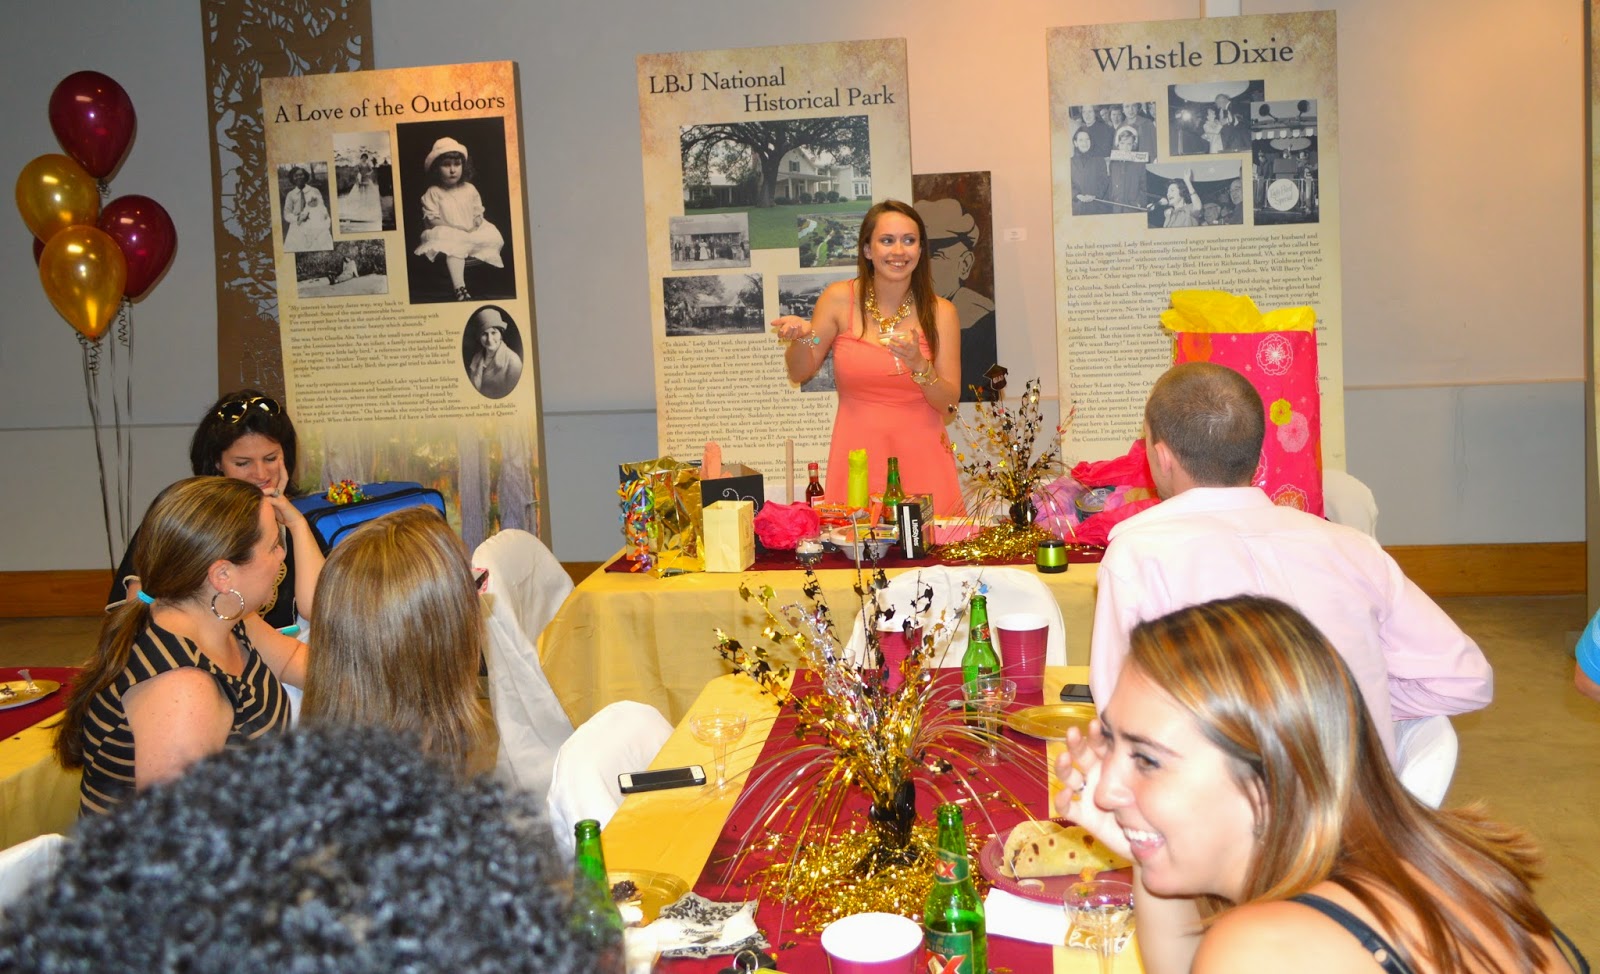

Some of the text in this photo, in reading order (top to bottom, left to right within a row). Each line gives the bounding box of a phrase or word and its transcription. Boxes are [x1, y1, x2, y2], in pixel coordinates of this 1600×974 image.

[1091, 37, 1294, 72] Whistle Dixie
[649, 66, 786, 94] LBJ National
[274, 92, 505, 124] A Love of the Outdoors
[743, 84, 896, 112] Historical Park
